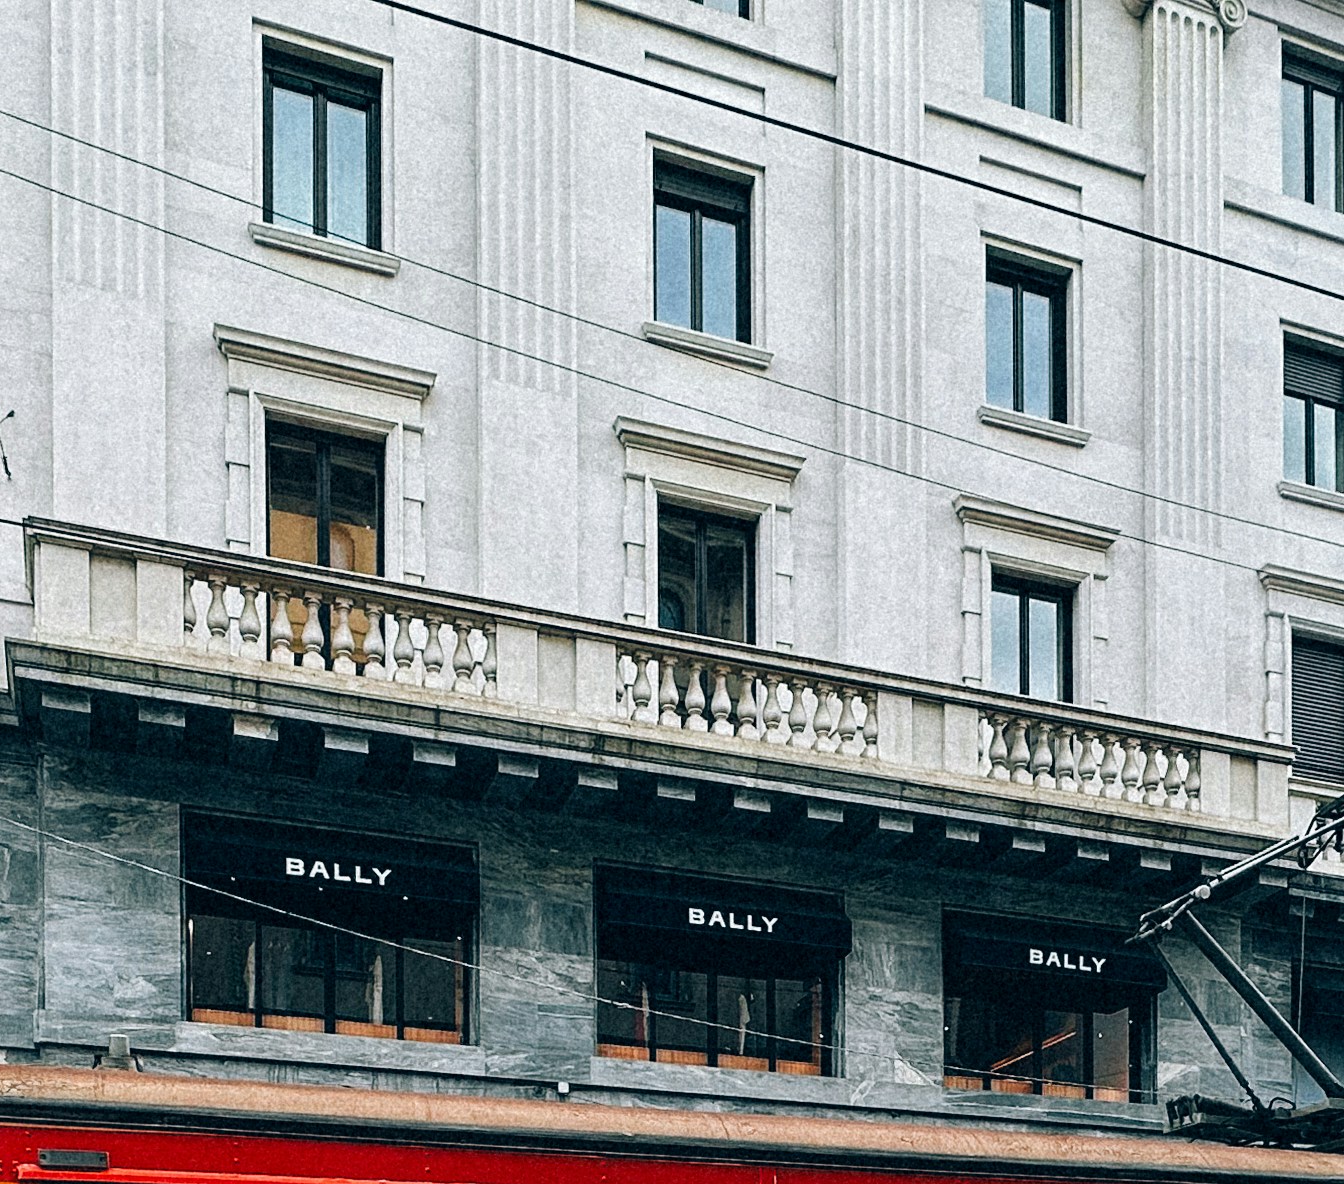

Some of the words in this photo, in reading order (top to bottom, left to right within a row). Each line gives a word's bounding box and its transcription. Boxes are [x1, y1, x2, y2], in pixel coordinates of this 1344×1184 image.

[285, 857, 393, 886] BALLY
[688, 907, 779, 933] BALLY
[1029, 948, 1107, 973] BALLY
